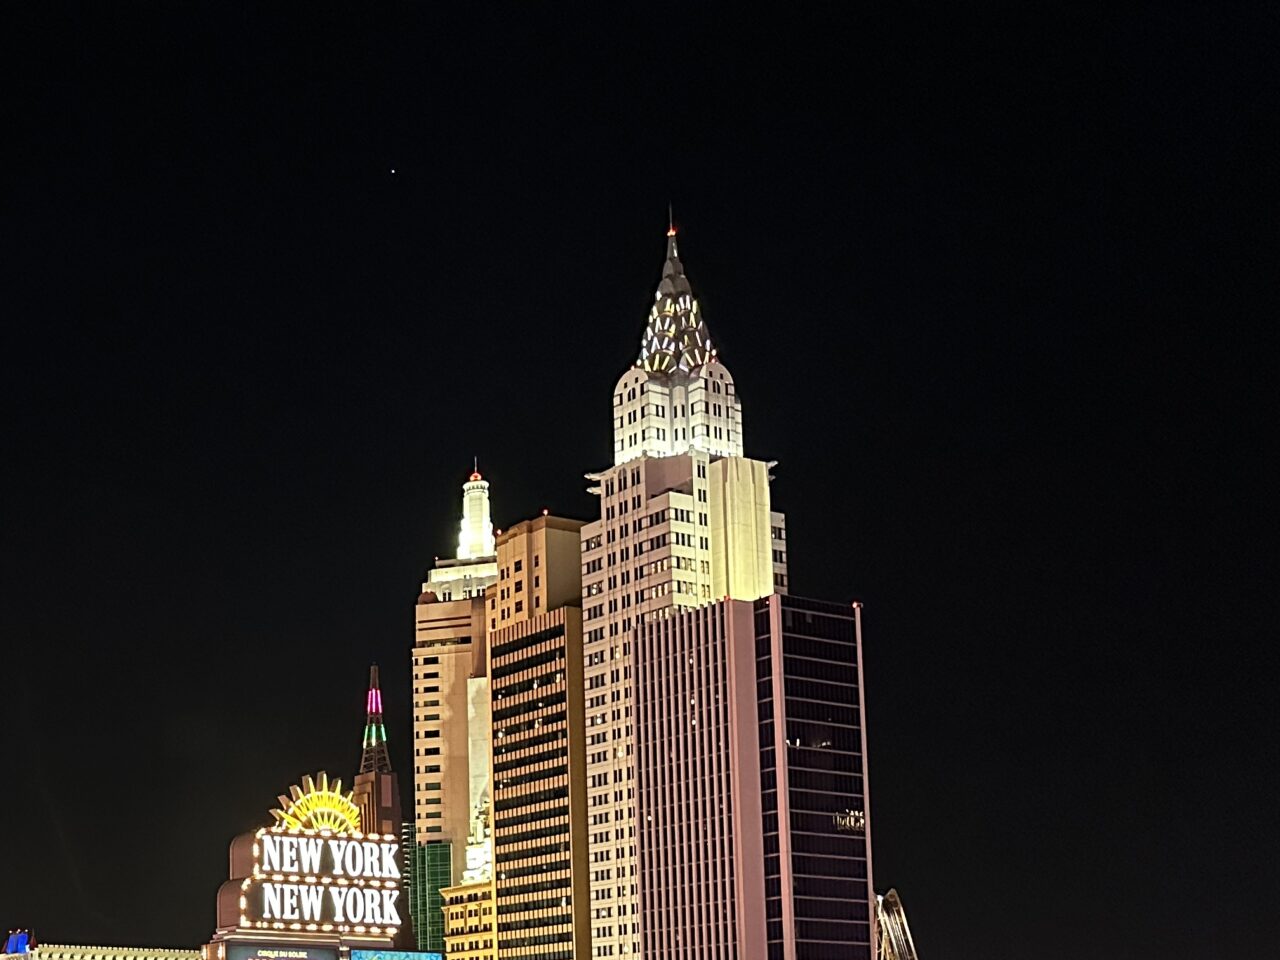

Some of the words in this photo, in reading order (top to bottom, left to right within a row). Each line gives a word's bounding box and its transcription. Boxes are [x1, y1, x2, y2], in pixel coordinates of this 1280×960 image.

[262, 835, 324, 874] NEW
[328, 840, 401, 879] YORK
[263, 883, 325, 921] NEW
[329, 886, 401, 925] YORK
